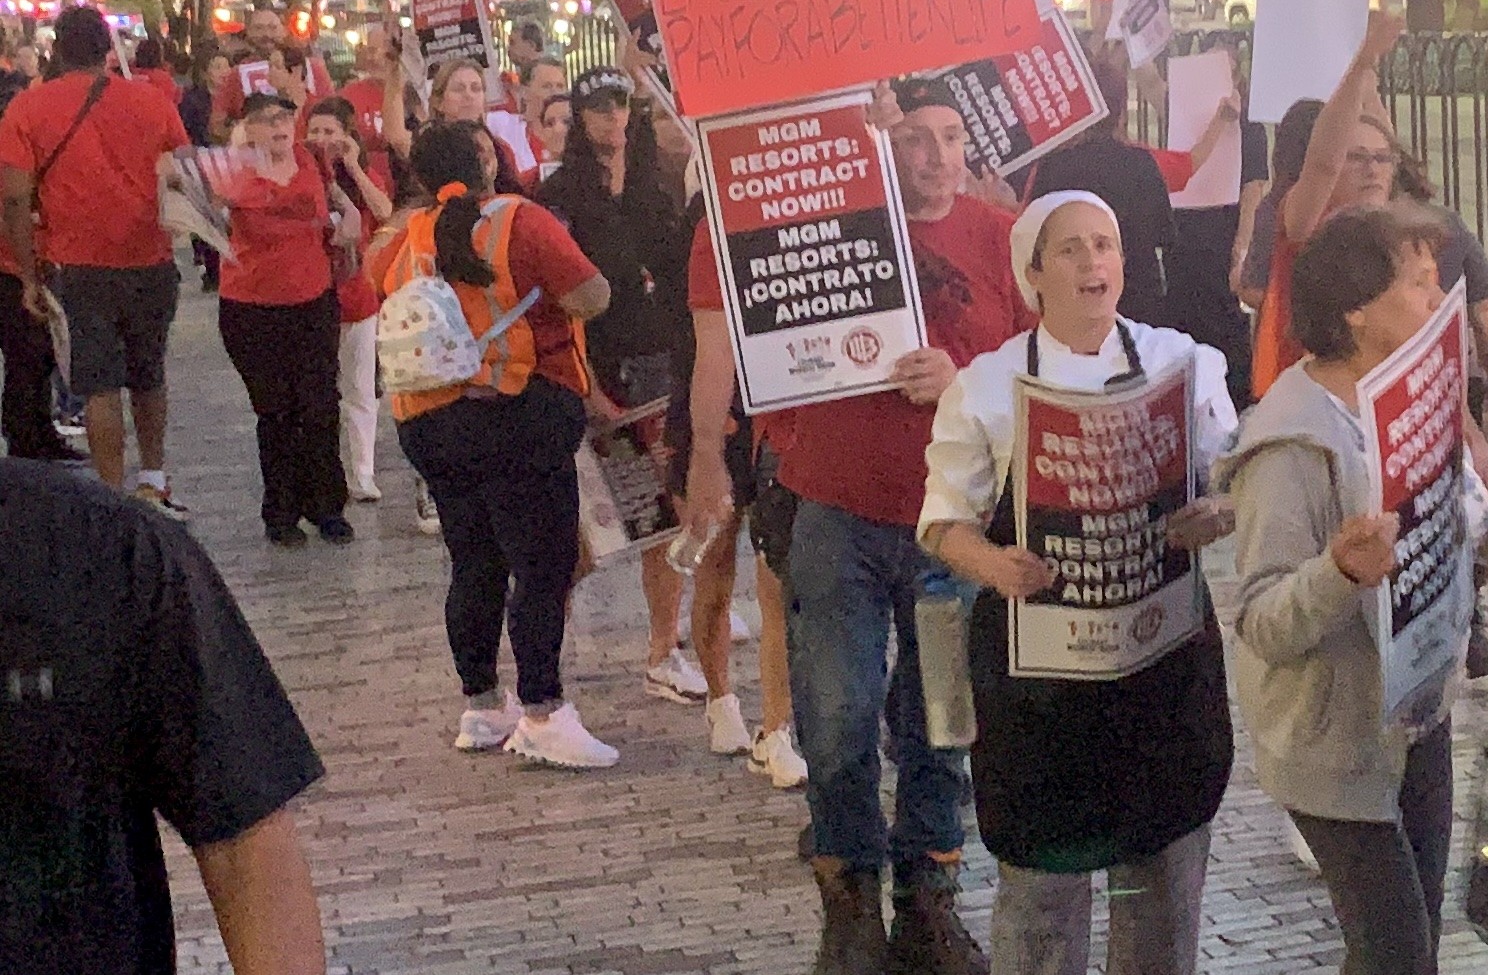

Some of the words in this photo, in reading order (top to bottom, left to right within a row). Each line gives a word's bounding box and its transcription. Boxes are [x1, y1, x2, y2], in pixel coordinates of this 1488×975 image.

[1014, 51, 1061, 128] ONTRACT
[758, 118, 821, 146] MGM
[730, 137, 860, 176] RESORTS:
[728, 158, 869, 202] CONTRACT
[761, 187, 846, 220] NOW!!!
[777, 219, 841, 249] MGM
[749, 238, 879, 278] RESORTS:
[744, 259, 894, 308] ¡CONTRATO
[775, 287, 874, 324] AHORA!
